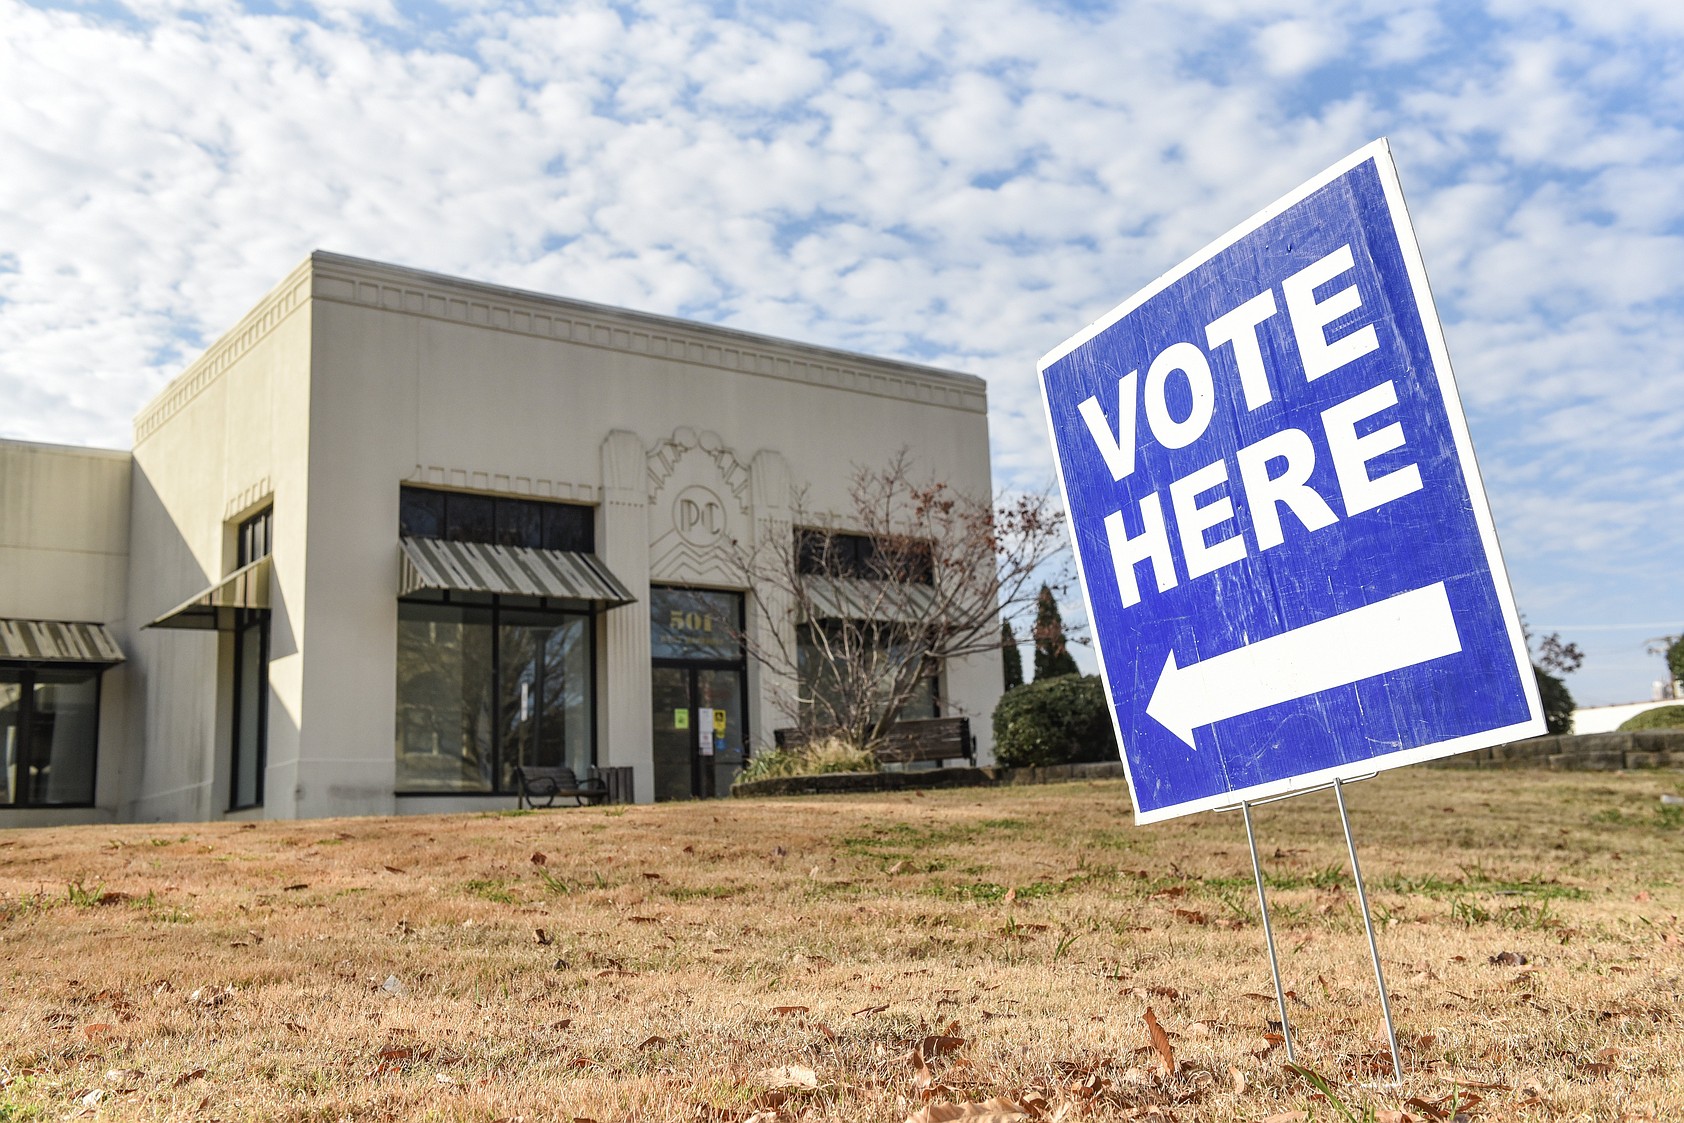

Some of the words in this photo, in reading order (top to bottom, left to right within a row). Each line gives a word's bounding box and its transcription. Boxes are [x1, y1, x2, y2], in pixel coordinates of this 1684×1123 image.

[1078, 243, 1379, 482] VOTE
[1104, 380, 1423, 608] HERE
[670, 610, 713, 632] 501
